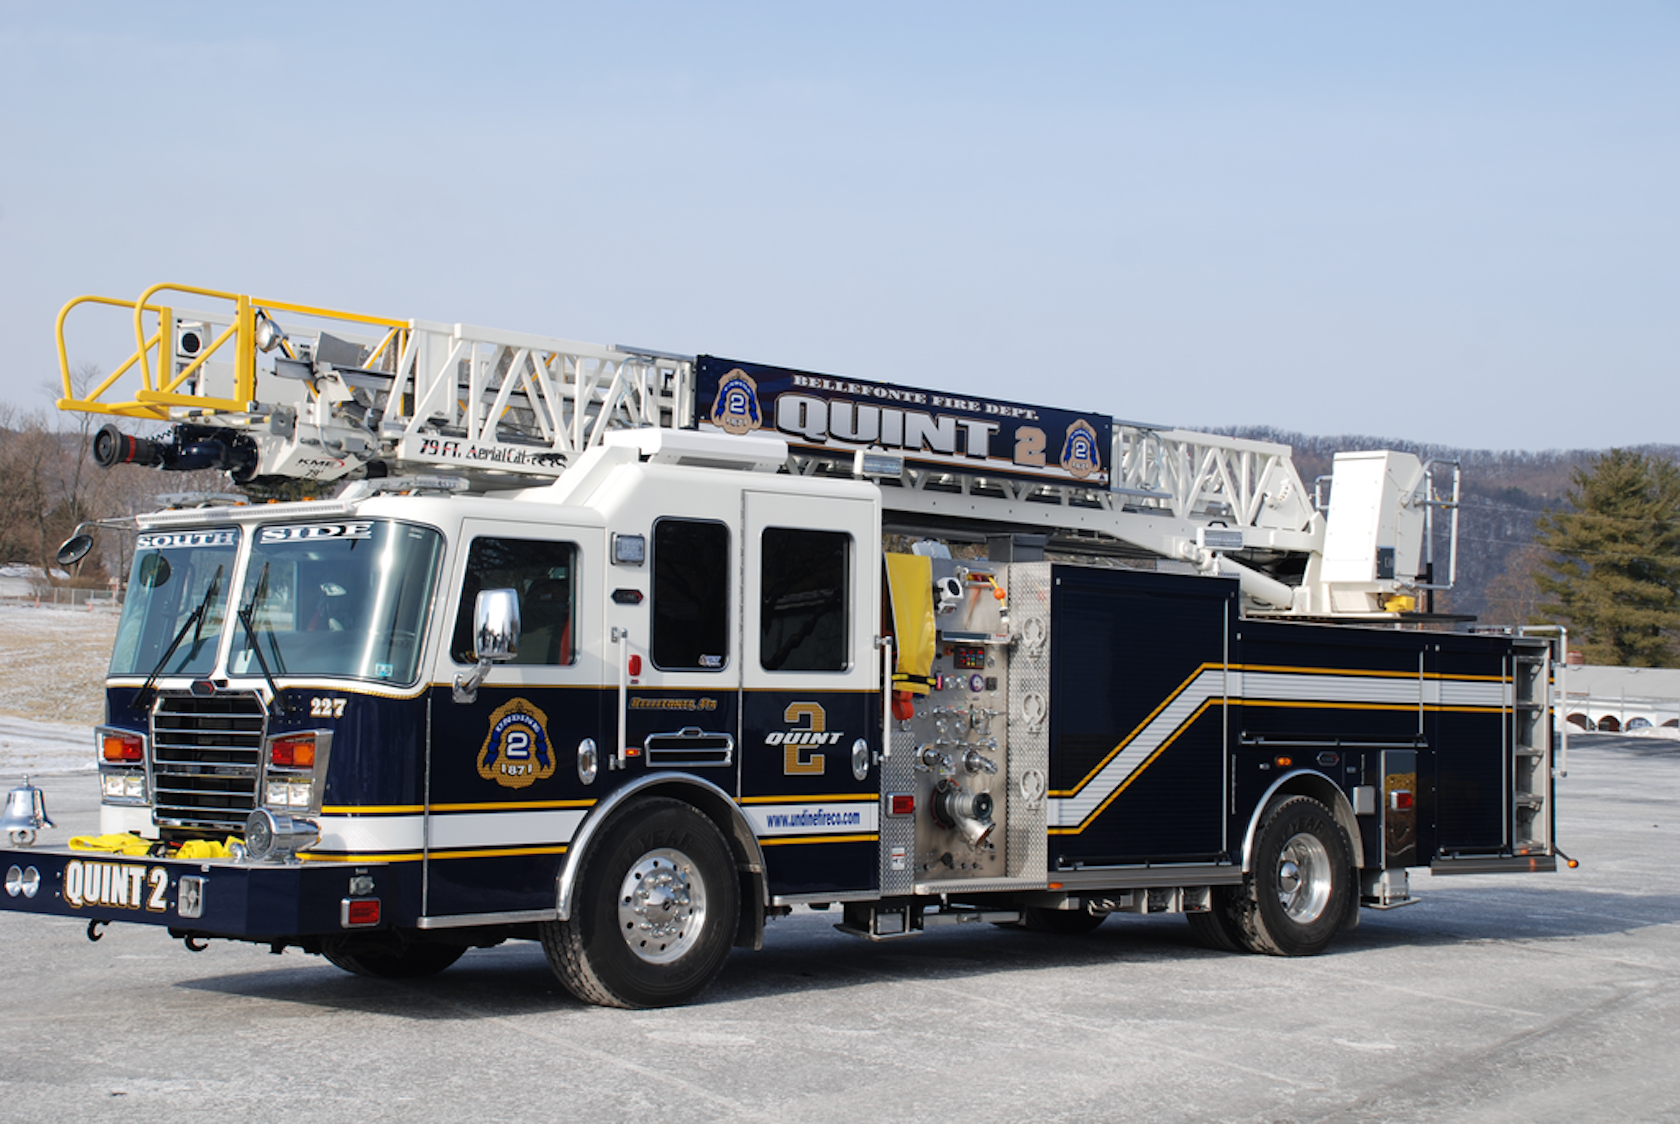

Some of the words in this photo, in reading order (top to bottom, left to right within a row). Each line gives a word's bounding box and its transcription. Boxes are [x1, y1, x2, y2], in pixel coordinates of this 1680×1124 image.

[730, 394, 744, 413] 2
[793, 373, 926, 405] BELLEFONTE
[932, 394, 981, 412] FIRE
[985, 403, 1040, 420] DEPT.
[775, 392, 1000, 459] QUINT
[1013, 425, 1047, 468] 2
[420, 438, 440, 456] 79
[1075, 441, 1087, 457] 2
[138, 532, 236, 547] SOUTH
[261, 523, 373, 541] SIDE
[310, 697, 347, 719] 227
[494, 712, 541, 733] UNDINE
[506, 731, 529, 757] 2
[764, 731, 844, 746] QUINT
[783, 701, 826, 776] 2
[501, 763, 534, 776] 1871
[766, 808, 860, 828] www.undinefireco.com
[64, 860, 147, 909] QUINT
[146, 866, 169, 913] 2
